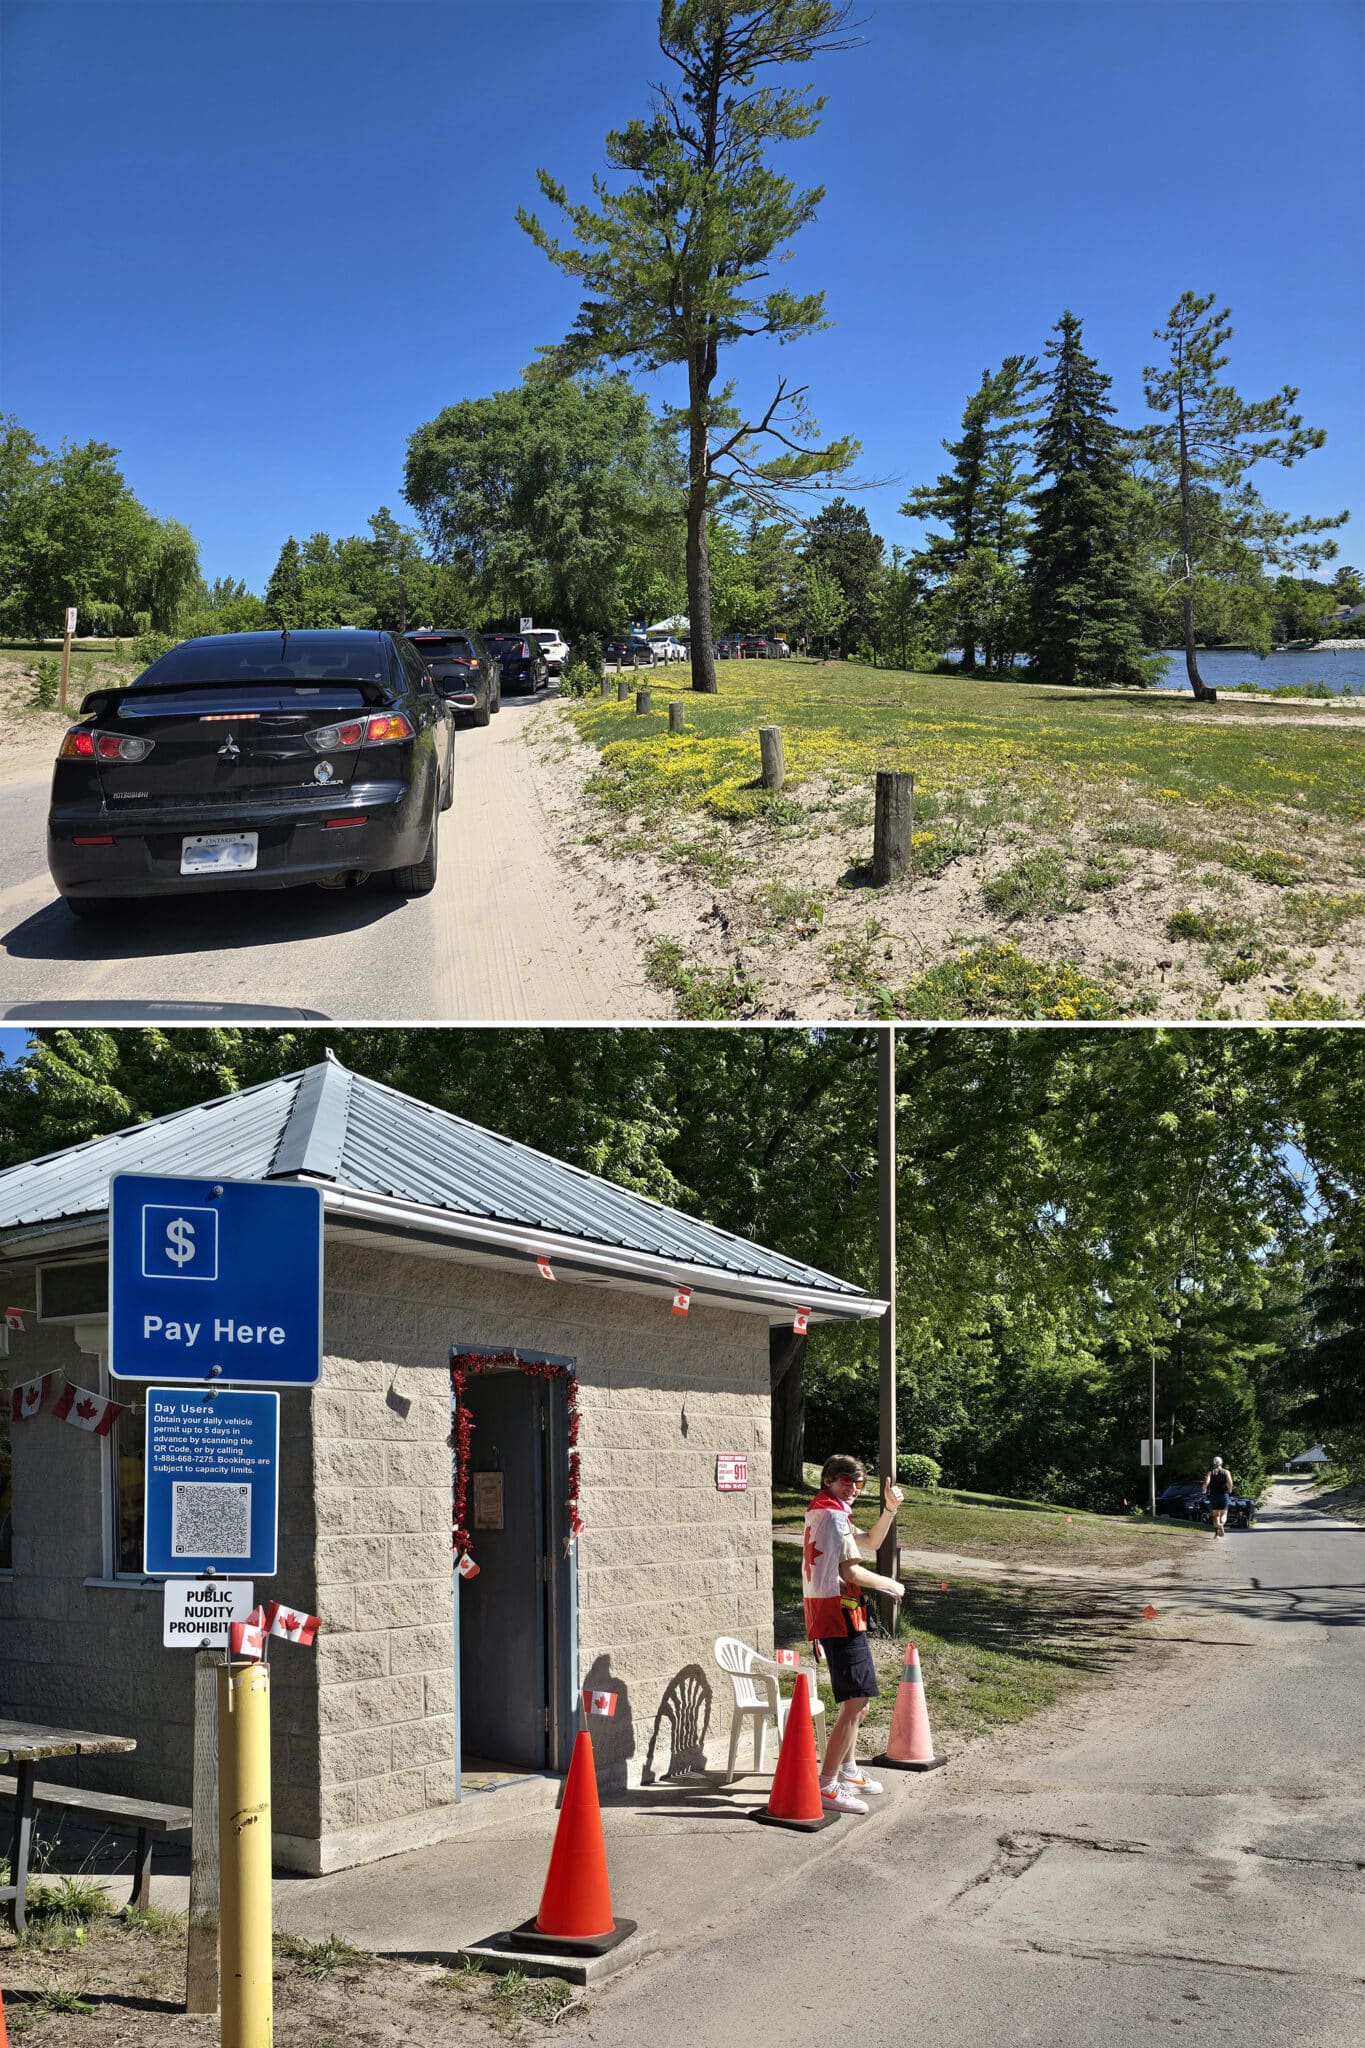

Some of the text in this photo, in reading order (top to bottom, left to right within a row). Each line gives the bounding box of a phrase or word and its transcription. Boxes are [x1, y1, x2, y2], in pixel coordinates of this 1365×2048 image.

[205, 837, 236, 845] ONTARIO
[165, 1217, 195, 1268] $
[144, 1315, 286, 1347] Pay Here
[155, 1404, 214, 1414] Day Users
[154, 1415, 180, 1423] Obtain
[203, 1417, 222, 1425] daily
[154, 1425, 179, 1433] permit
[211, 1427, 230, 1435] days
[154, 1435, 187, 1443] advance
[190, 1436, 199, 1444] by
[201, 1437, 238, 1446] scanning
[205, 1446, 215, 1454] by
[217, 1447, 243, 1455] calling
[218, 1456, 255, 1464] Bookings
[153, 1465, 184, 1473] subject
[195, 1466, 228, 1474] capacity
[734, 1464, 746, 1480] 911
[187, 1591, 232, 1602] PUBLIC
[185, 1607, 234, 1618] NUDITY
[170, 1622, 228, 1633] PROHIBIT
